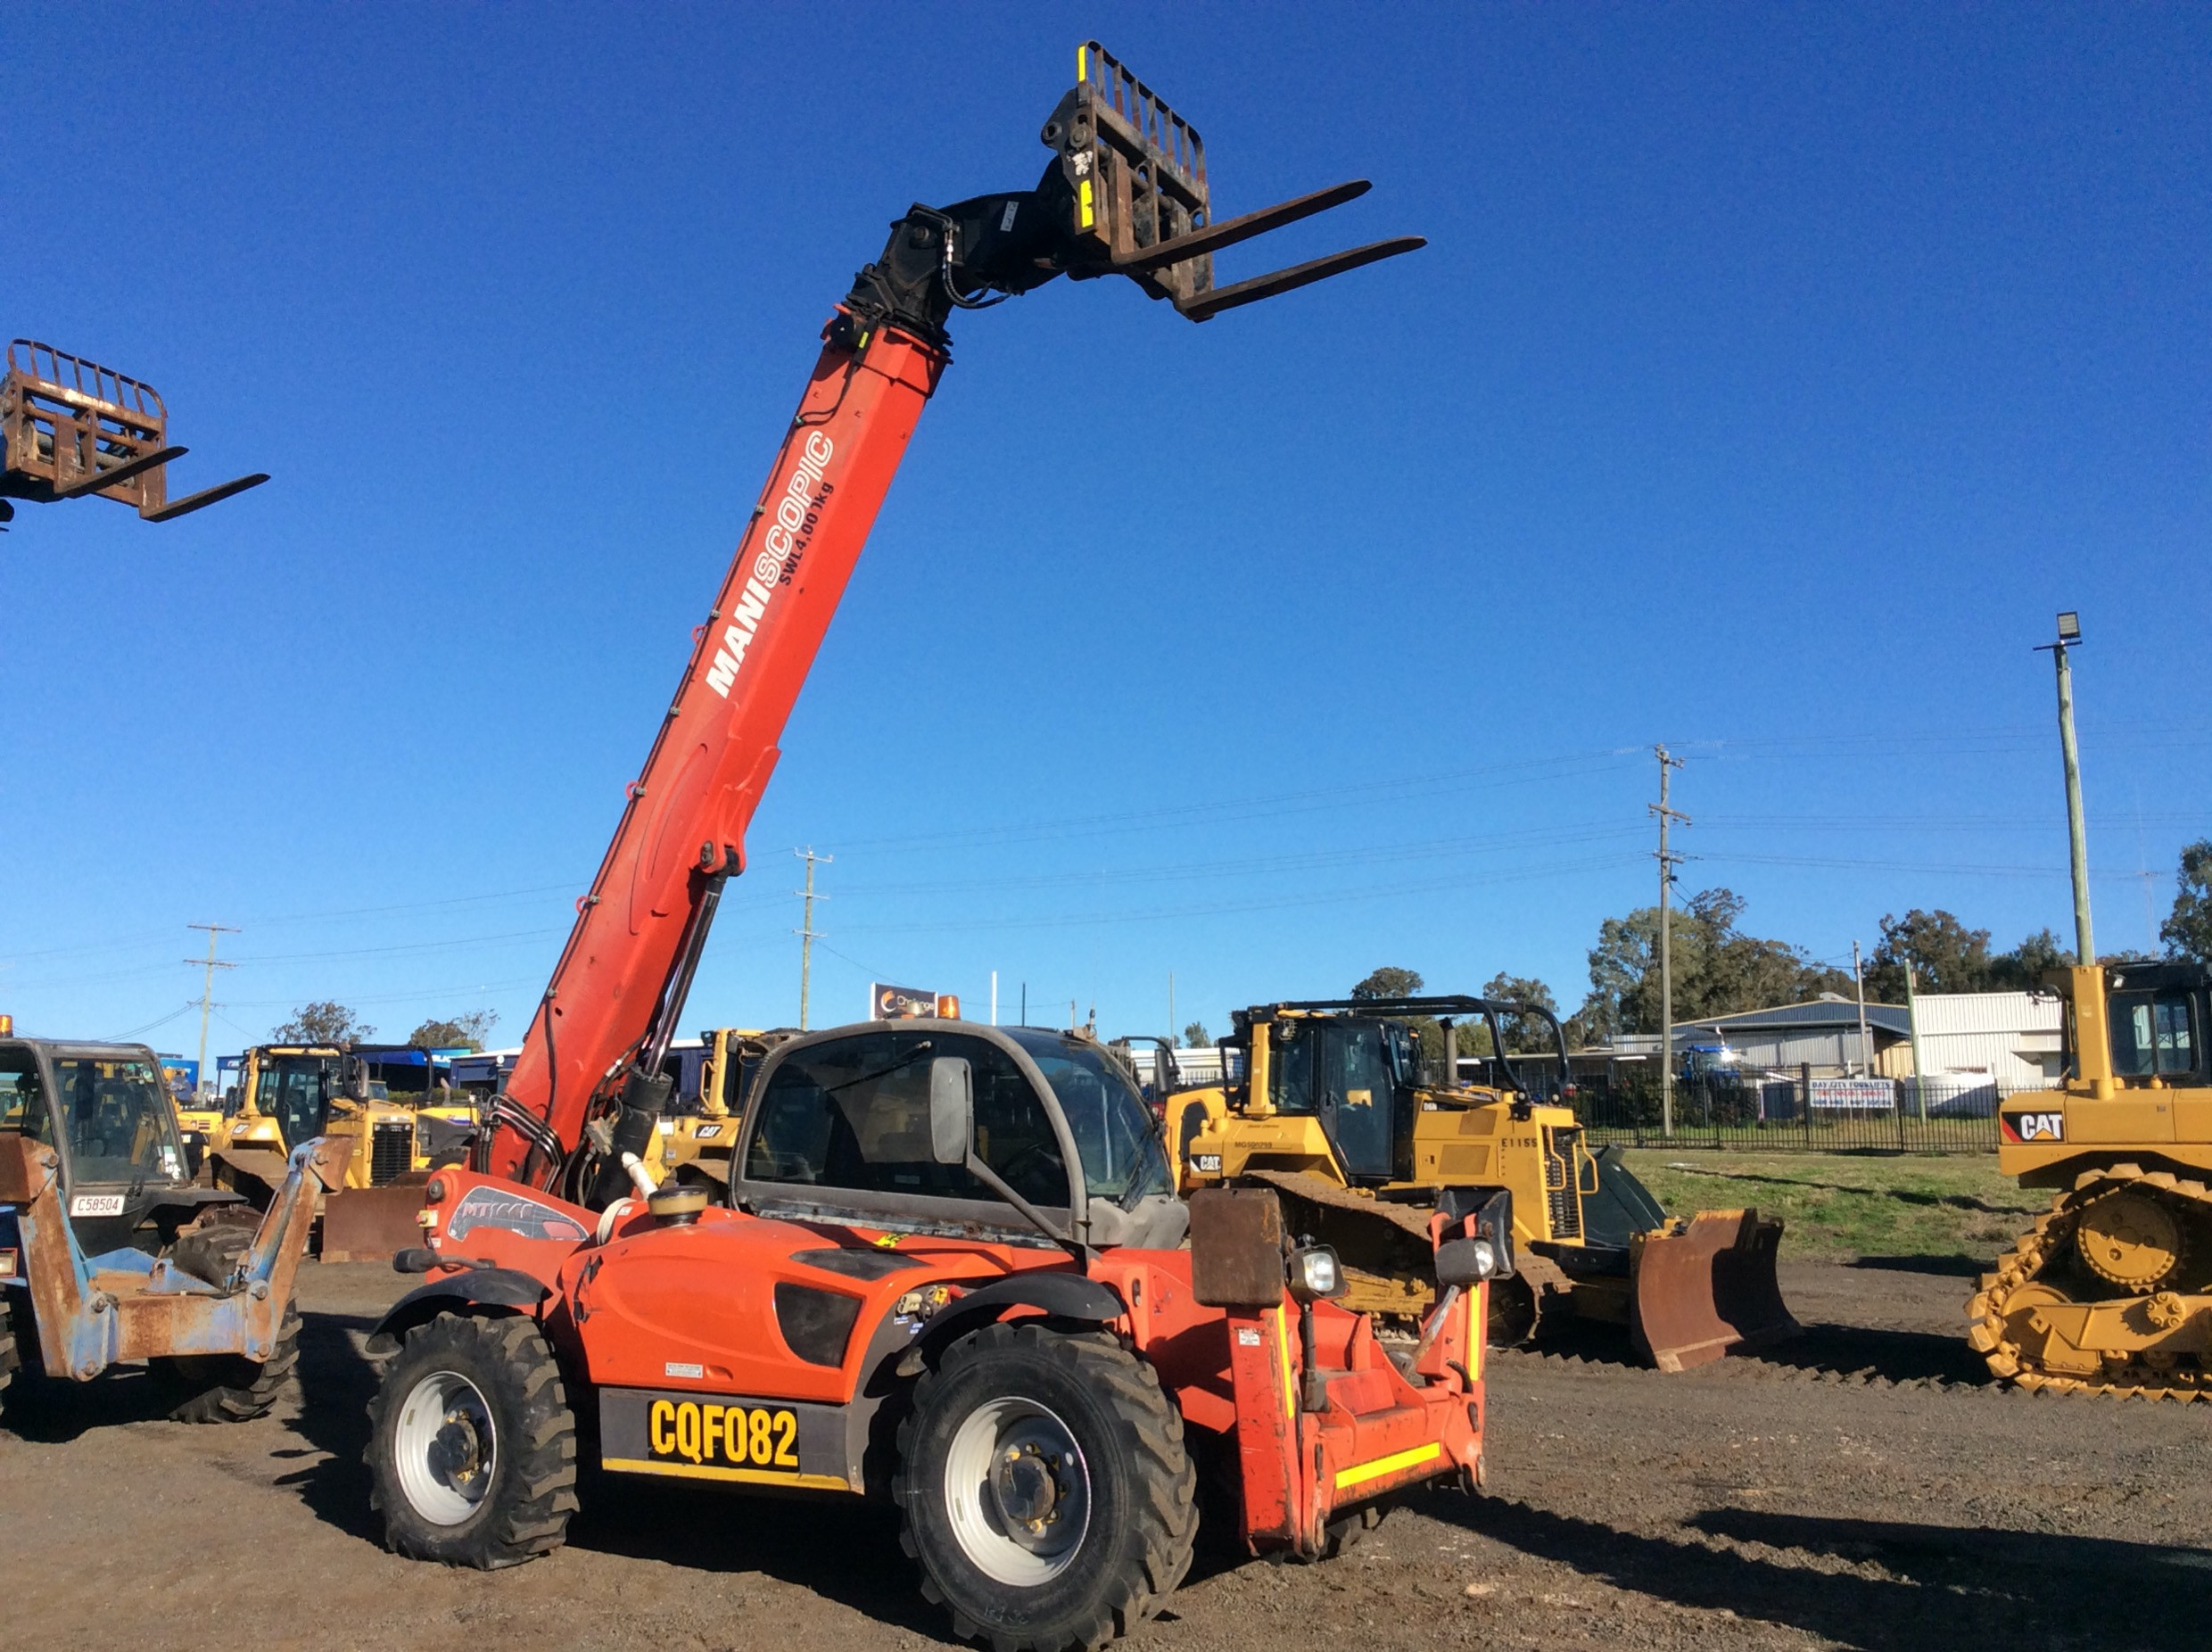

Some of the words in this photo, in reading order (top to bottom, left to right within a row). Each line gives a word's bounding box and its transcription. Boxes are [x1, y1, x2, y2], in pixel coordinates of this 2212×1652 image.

[706, 431, 834, 699] MANISCOPIC
[2020, 1114, 2063, 1140] CAT
[1501, 1138, 1538, 1148] E1155
[1200, 1155, 1221, 1171] CAT
[78, 1197, 120, 1211] C58504
